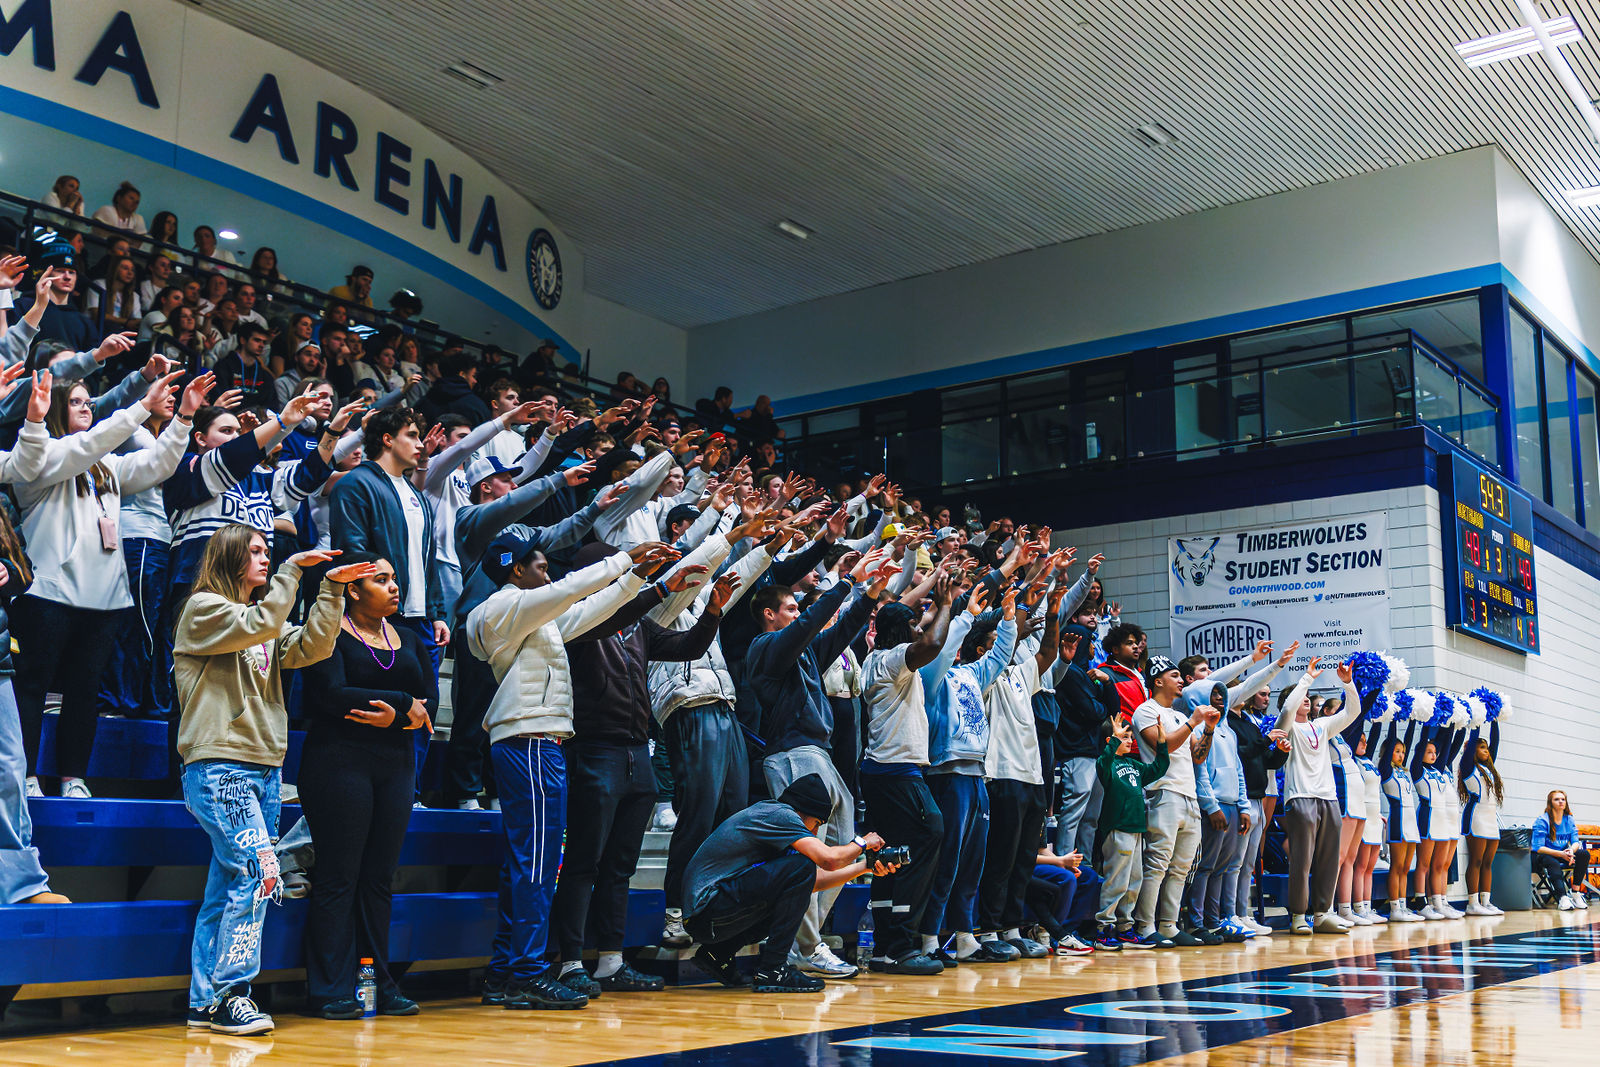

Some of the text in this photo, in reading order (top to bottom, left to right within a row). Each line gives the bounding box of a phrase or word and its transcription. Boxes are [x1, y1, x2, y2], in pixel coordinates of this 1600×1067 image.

[229, 73, 507, 272] ARENA
[1480, 474, 1504, 518] 54.3
[1236, 522, 1367, 554] TIMBERWOLVES
[1465, 530, 1480, 567] 48
[1224, 548, 1383, 582] STUDENT SECTION
[1496, 547, 1502, 573] 3
[1519, 557, 1532, 591] 48
[1251, 596, 1309, 607] @NUTIMBERWOLVES
[1324, 589, 1386, 601] @NUTIMBERWOLVES
[1195, 603, 1236, 611] TIMBERWOLVES
[1482, 601, 1488, 628] 3
[1303, 628, 1363, 639] www.mfcu.net
[1323, 619, 1342, 627] Visit
[1191, 626, 1265, 656] MEMBERS
[1306, 641, 1318, 649] for
[1343, 638, 1361, 646] info!
[1529, 621, 1535, 647] 5
[1288, 662, 1339, 671] NORTWOOD
[1296, 653, 1353, 663] PRO SPONS
[223, 796, 251, 813] TAKE
[226, 808, 255, 829] TIME
[229, 939, 258, 954] GOOD
[227, 950, 255, 966] TIME
[829, 930, 1600, 1061] NORTHWO
